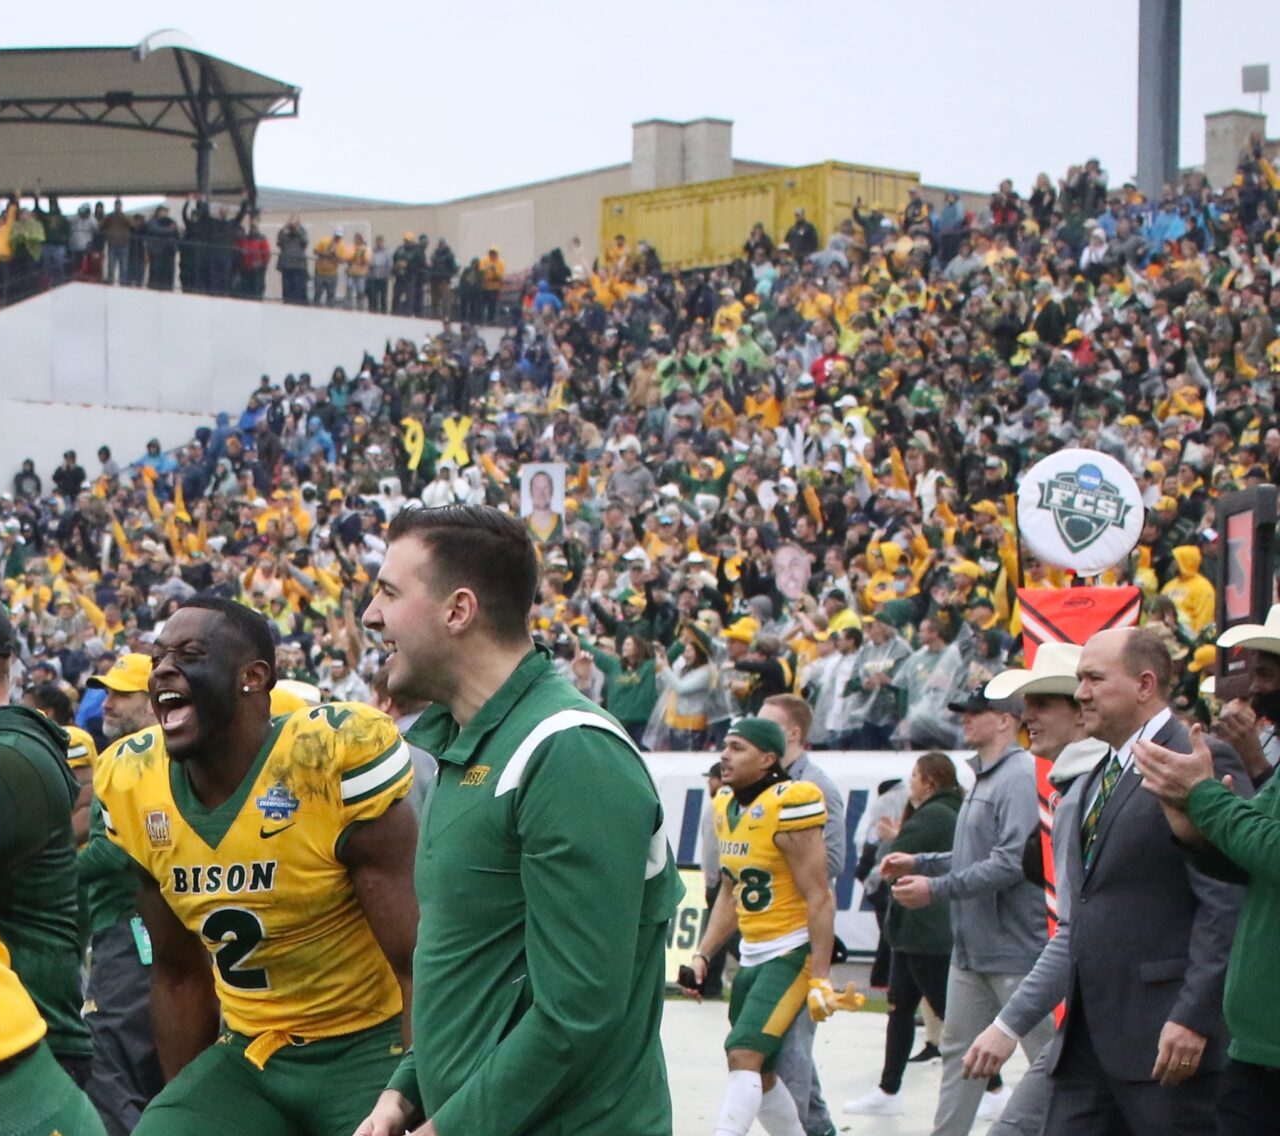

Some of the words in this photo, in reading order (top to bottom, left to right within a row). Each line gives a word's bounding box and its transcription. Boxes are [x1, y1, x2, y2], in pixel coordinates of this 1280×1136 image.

[440, 415, 473, 467] X
[1049, 487, 1120, 519] FCS
[173, 860, 277, 894] BISON
[200, 906, 271, 992] 2
